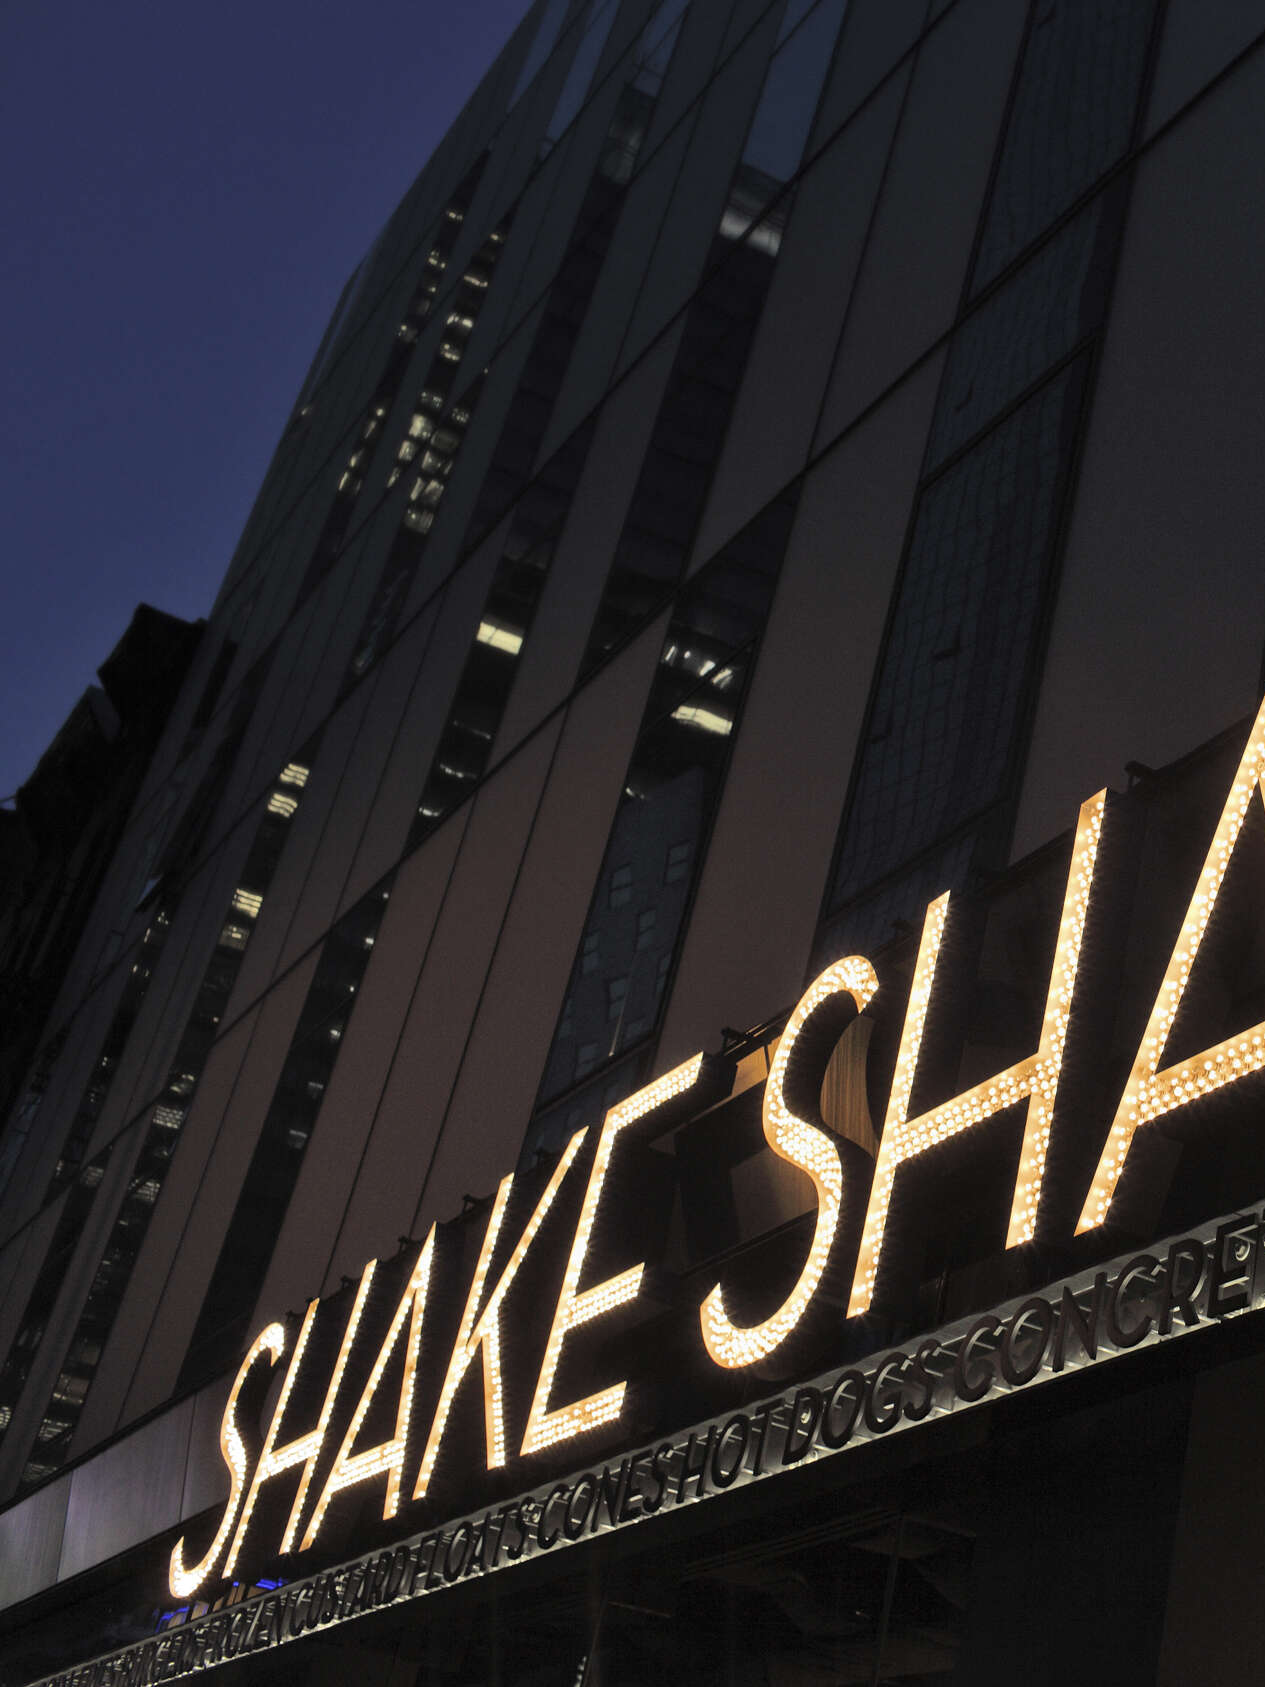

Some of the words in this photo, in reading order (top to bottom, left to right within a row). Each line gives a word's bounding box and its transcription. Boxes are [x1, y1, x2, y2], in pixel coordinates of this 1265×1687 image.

[168, 1051, 704, 1599] SHAKE
[289, 1545, 411, 1636] CUSTARD
[410, 1496, 536, 1596] FLOATS
[537, 1442, 673, 1549] CONES
[675, 1397, 784, 1503] HOT
[782, 1339, 943, 1465] DOGS
